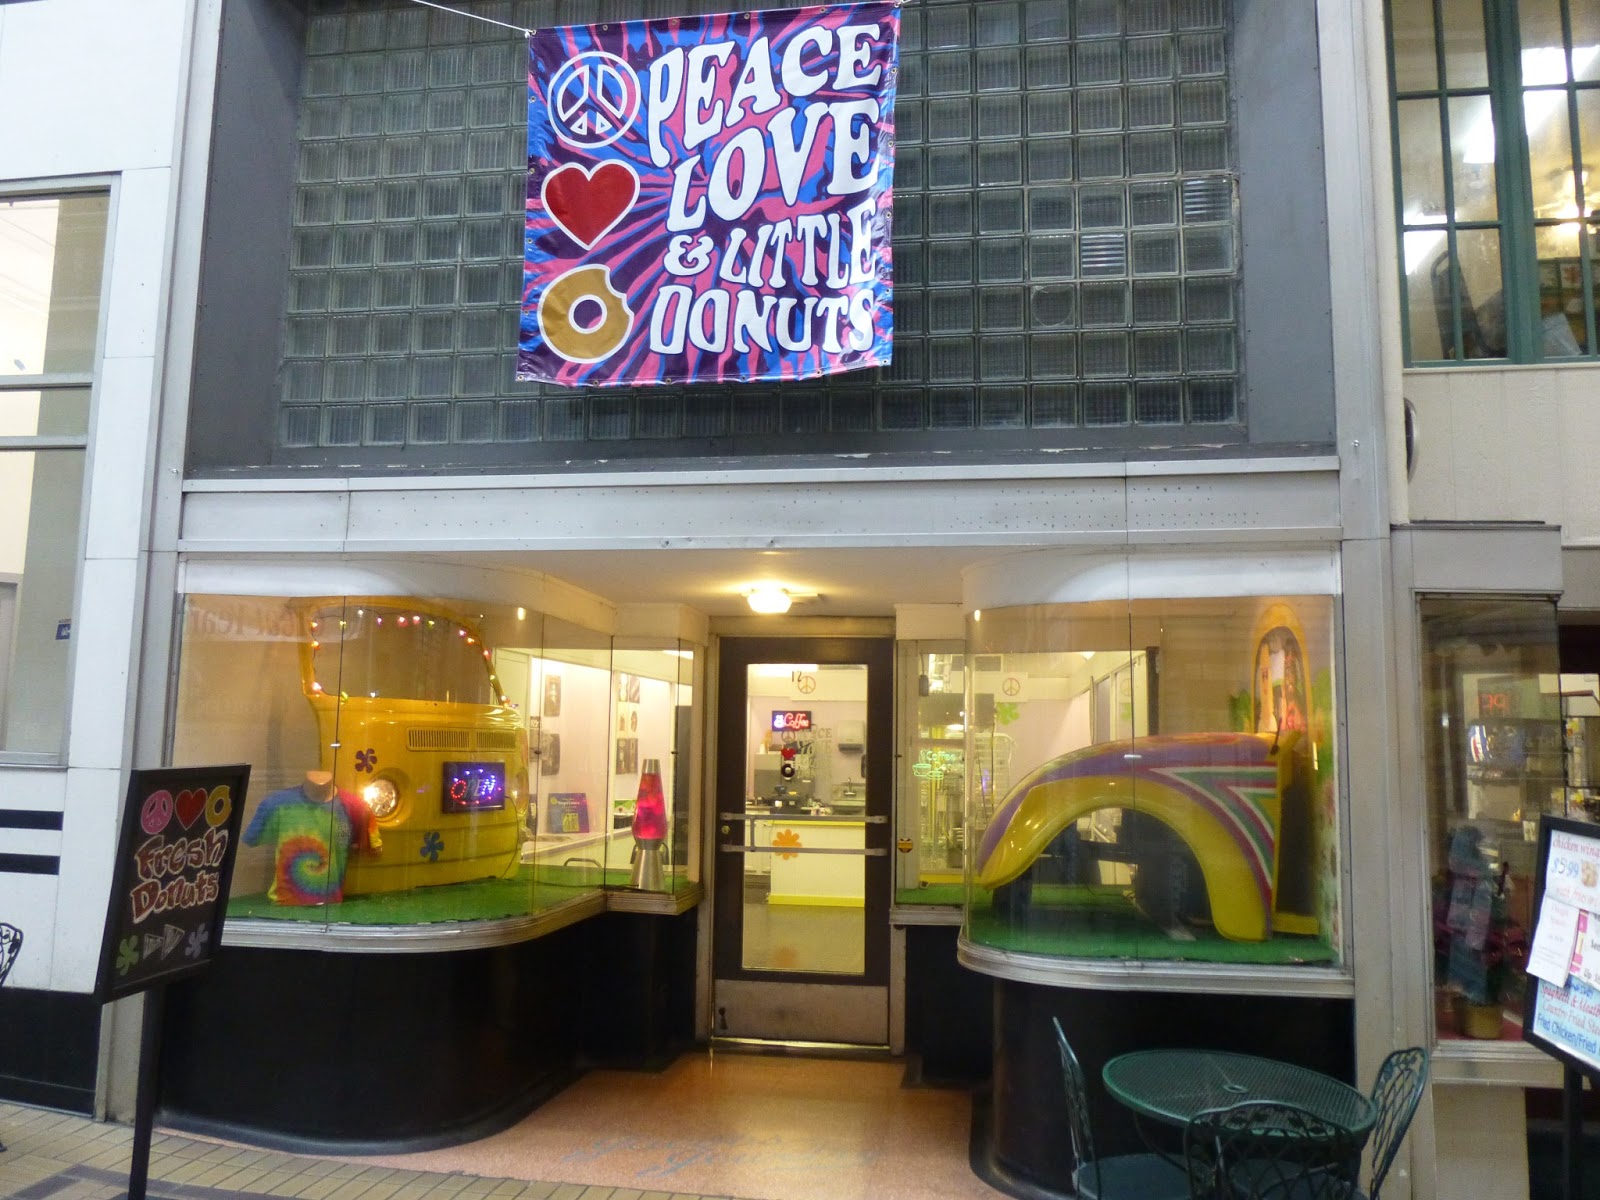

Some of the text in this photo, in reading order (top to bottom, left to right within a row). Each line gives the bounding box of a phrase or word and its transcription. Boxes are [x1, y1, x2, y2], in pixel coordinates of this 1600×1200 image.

[648, 23, 882, 167] PEACE
[666, 99, 880, 232] LOVE
[663, 198, 876, 288] & LITTLE
[649, 285, 875, 354] DONUTS
[784, 712, 809, 729] Coffee
[450, 778, 496, 799] OPEN
[134, 827, 229, 882] Fresh
[130, 870, 220, 924] Donuts
